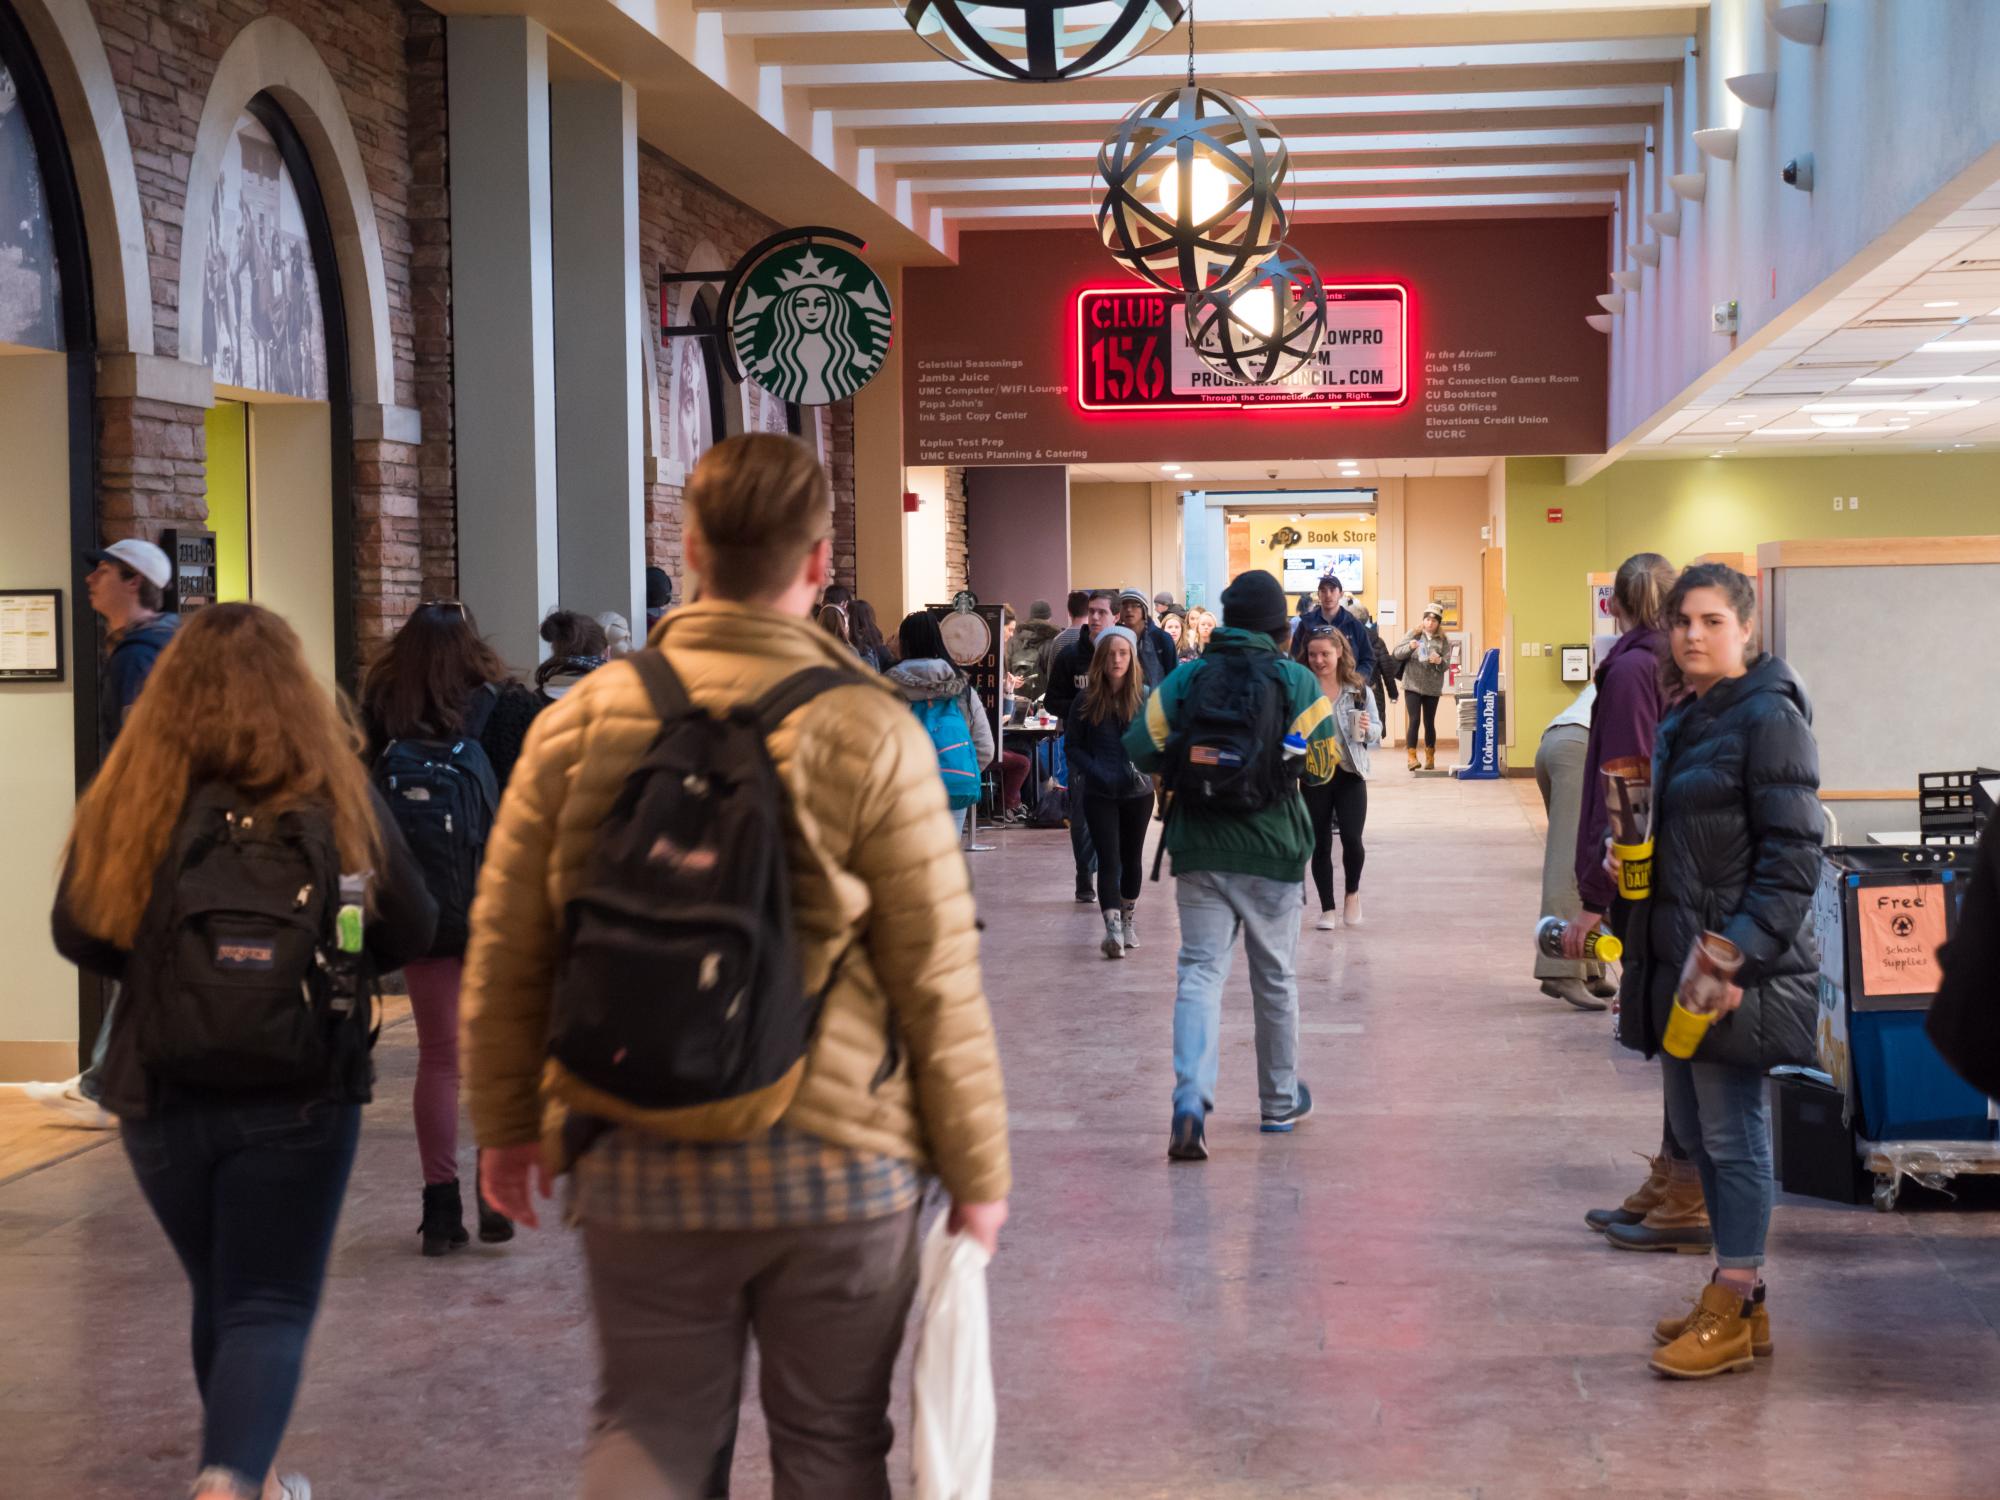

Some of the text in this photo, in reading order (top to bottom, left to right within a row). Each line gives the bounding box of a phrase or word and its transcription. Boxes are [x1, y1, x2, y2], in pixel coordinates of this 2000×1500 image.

[1092, 298, 1165, 329] CLUB
[1425, 350, 1497, 360] In the Atrium:
[918, 359, 1024, 369] Celestial Seasonings
[1092, 336, 1165, 400] 156
[1425, 363, 1471, 373] Club 156
[918, 372, 990, 382] Jamba Juice
[1425, 375, 1580, 386] The Connection Games Room
[918, 387, 942, 395] UMC
[1029, 385, 1069, 395] Lounge
[1425, 390, 1498, 400] CU Bookstore
[1201, 394, 1237, 402] Through
[1328, 392, 1342, 400] the
[1346, 392, 1373, 401] Right.
[919, 399, 984, 410] Papa John's
[1425, 403, 1498, 412] CUSG Offices
[919, 411, 1029, 422] Ink Spot Copy Center
[1426, 415, 1549, 426] Elevations Credit Union
[1426, 430, 1467, 439] CUCRC
[919, 438, 1005, 448] Kaplan Test Prep
[920, 449, 1088, 461] UMC Events Planning & Catering
[1307, 530, 1377, 543] Book Store
[1482, 689, 1497, 764] Colorado Daily
[1877, 896, 1925, 910] Free
[1885, 945, 1922, 955] School
[1881, 957, 1928, 971] Supplies
